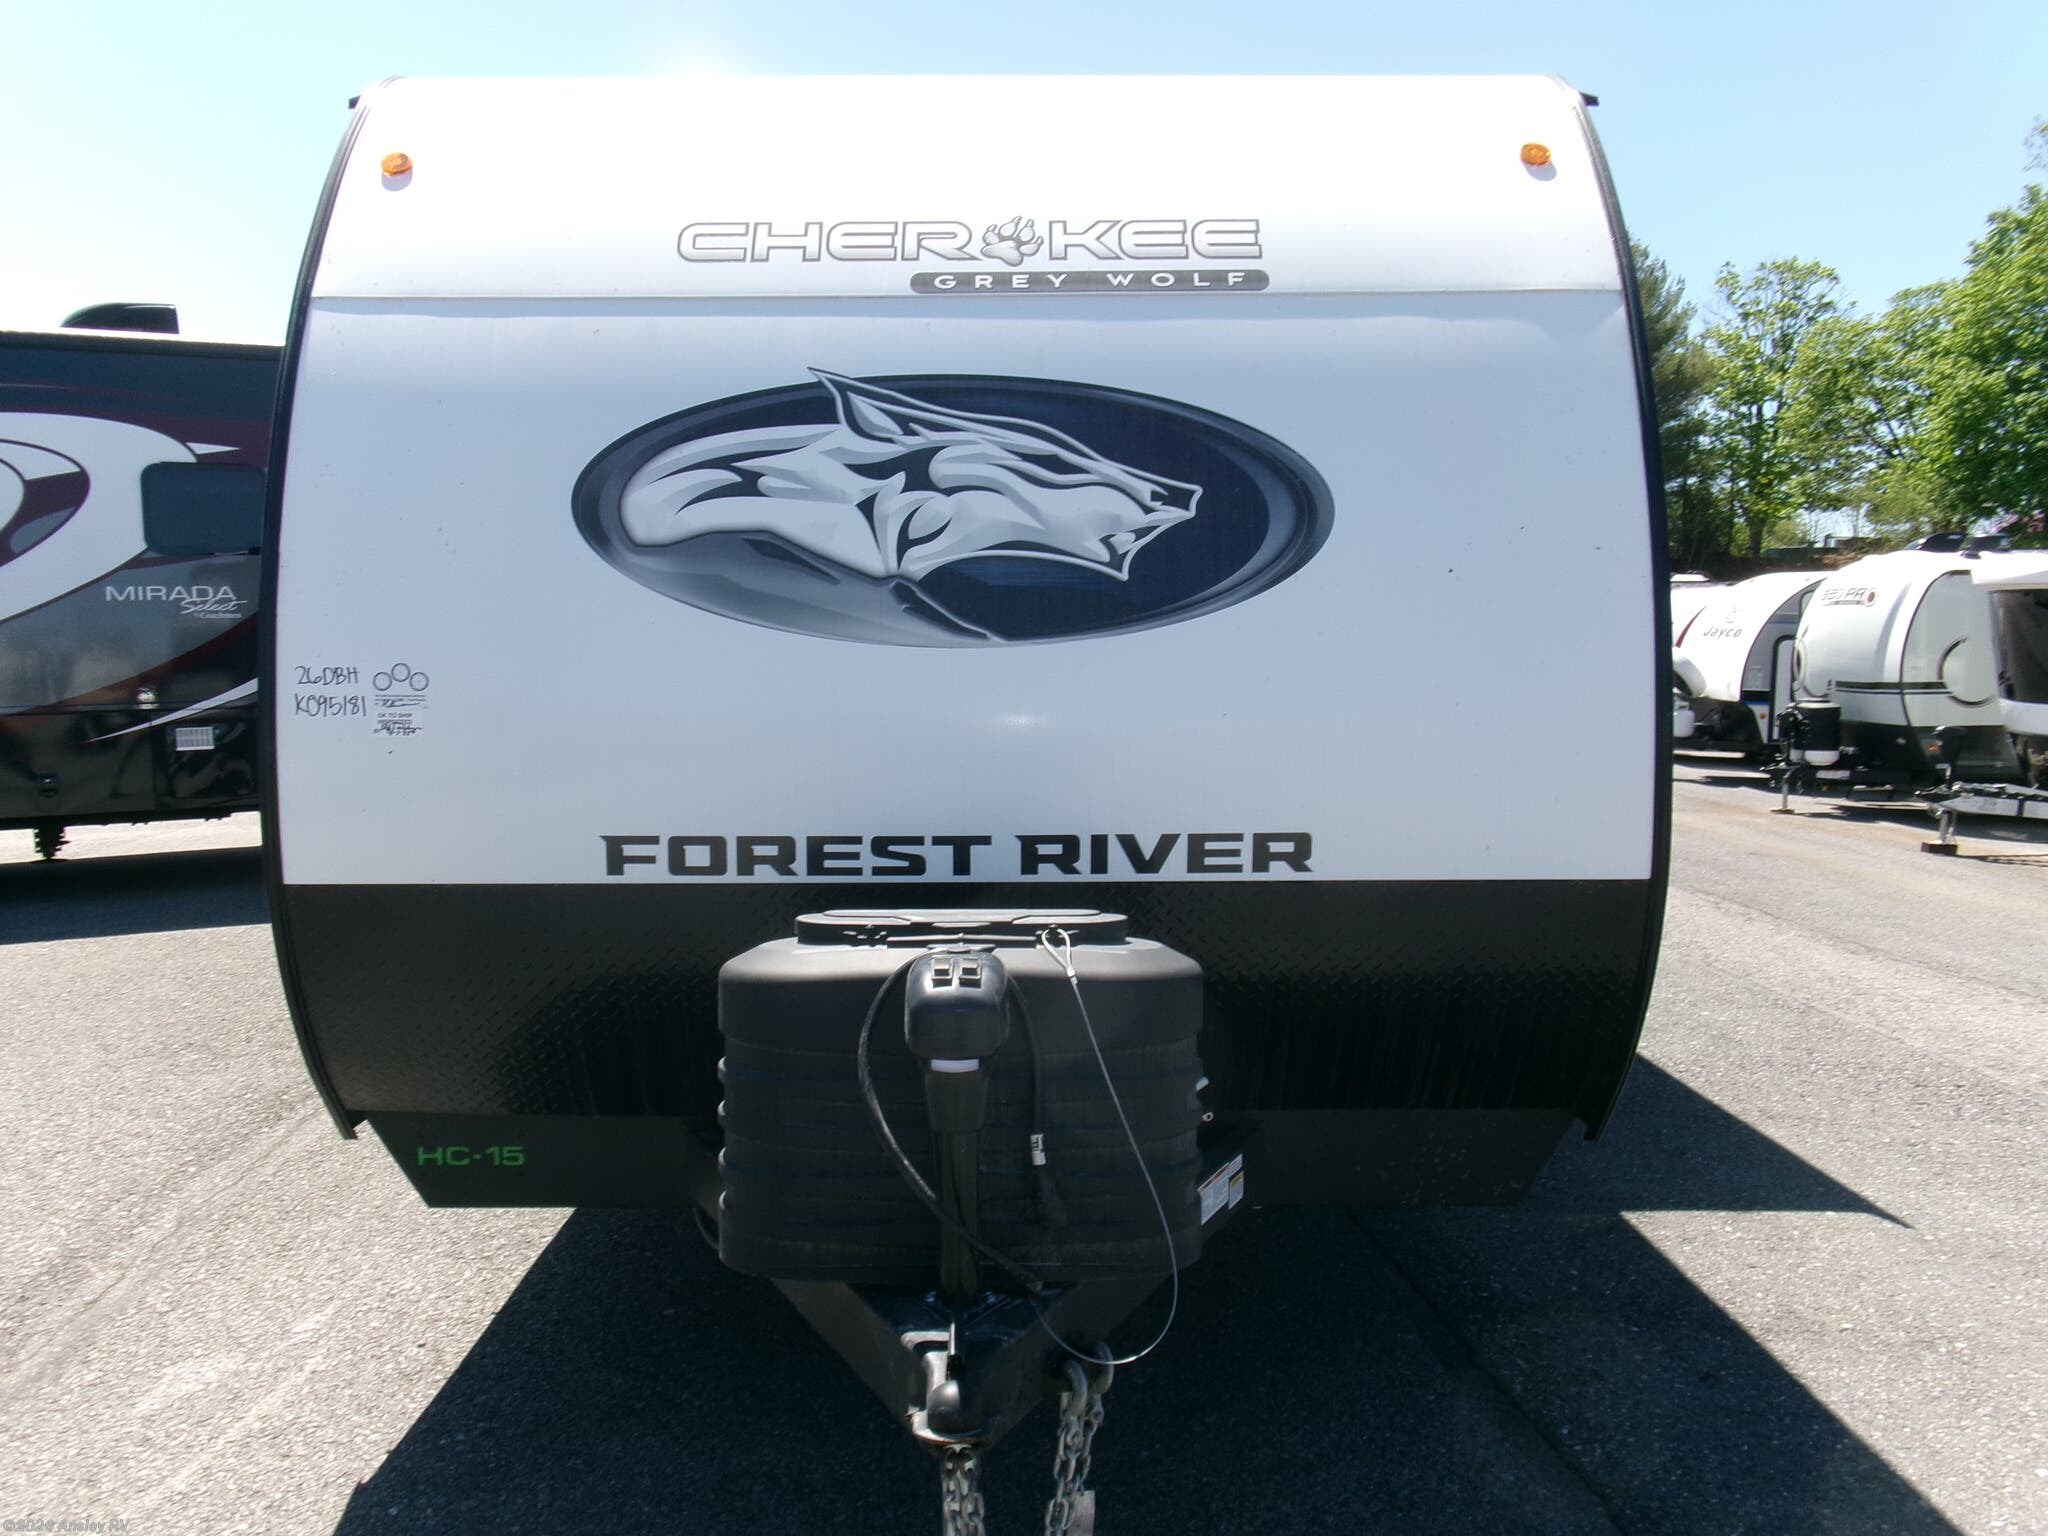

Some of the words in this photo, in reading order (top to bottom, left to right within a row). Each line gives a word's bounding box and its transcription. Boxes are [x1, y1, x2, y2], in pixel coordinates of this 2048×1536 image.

[677, 216, 1263, 264] CHERKEE
[933, 272, 1068, 290] GREY
[1105, 270, 1247, 288] WOLF
[105, 586, 237, 601] MIRADA
[180, 599, 248, 614] Select
[295, 665, 359, 686] 26DBH
[600, 834, 992, 877] FOREST
[1014, 832, 1313, 875] RIVER
[417, 1146, 526, 1166] HC-15
